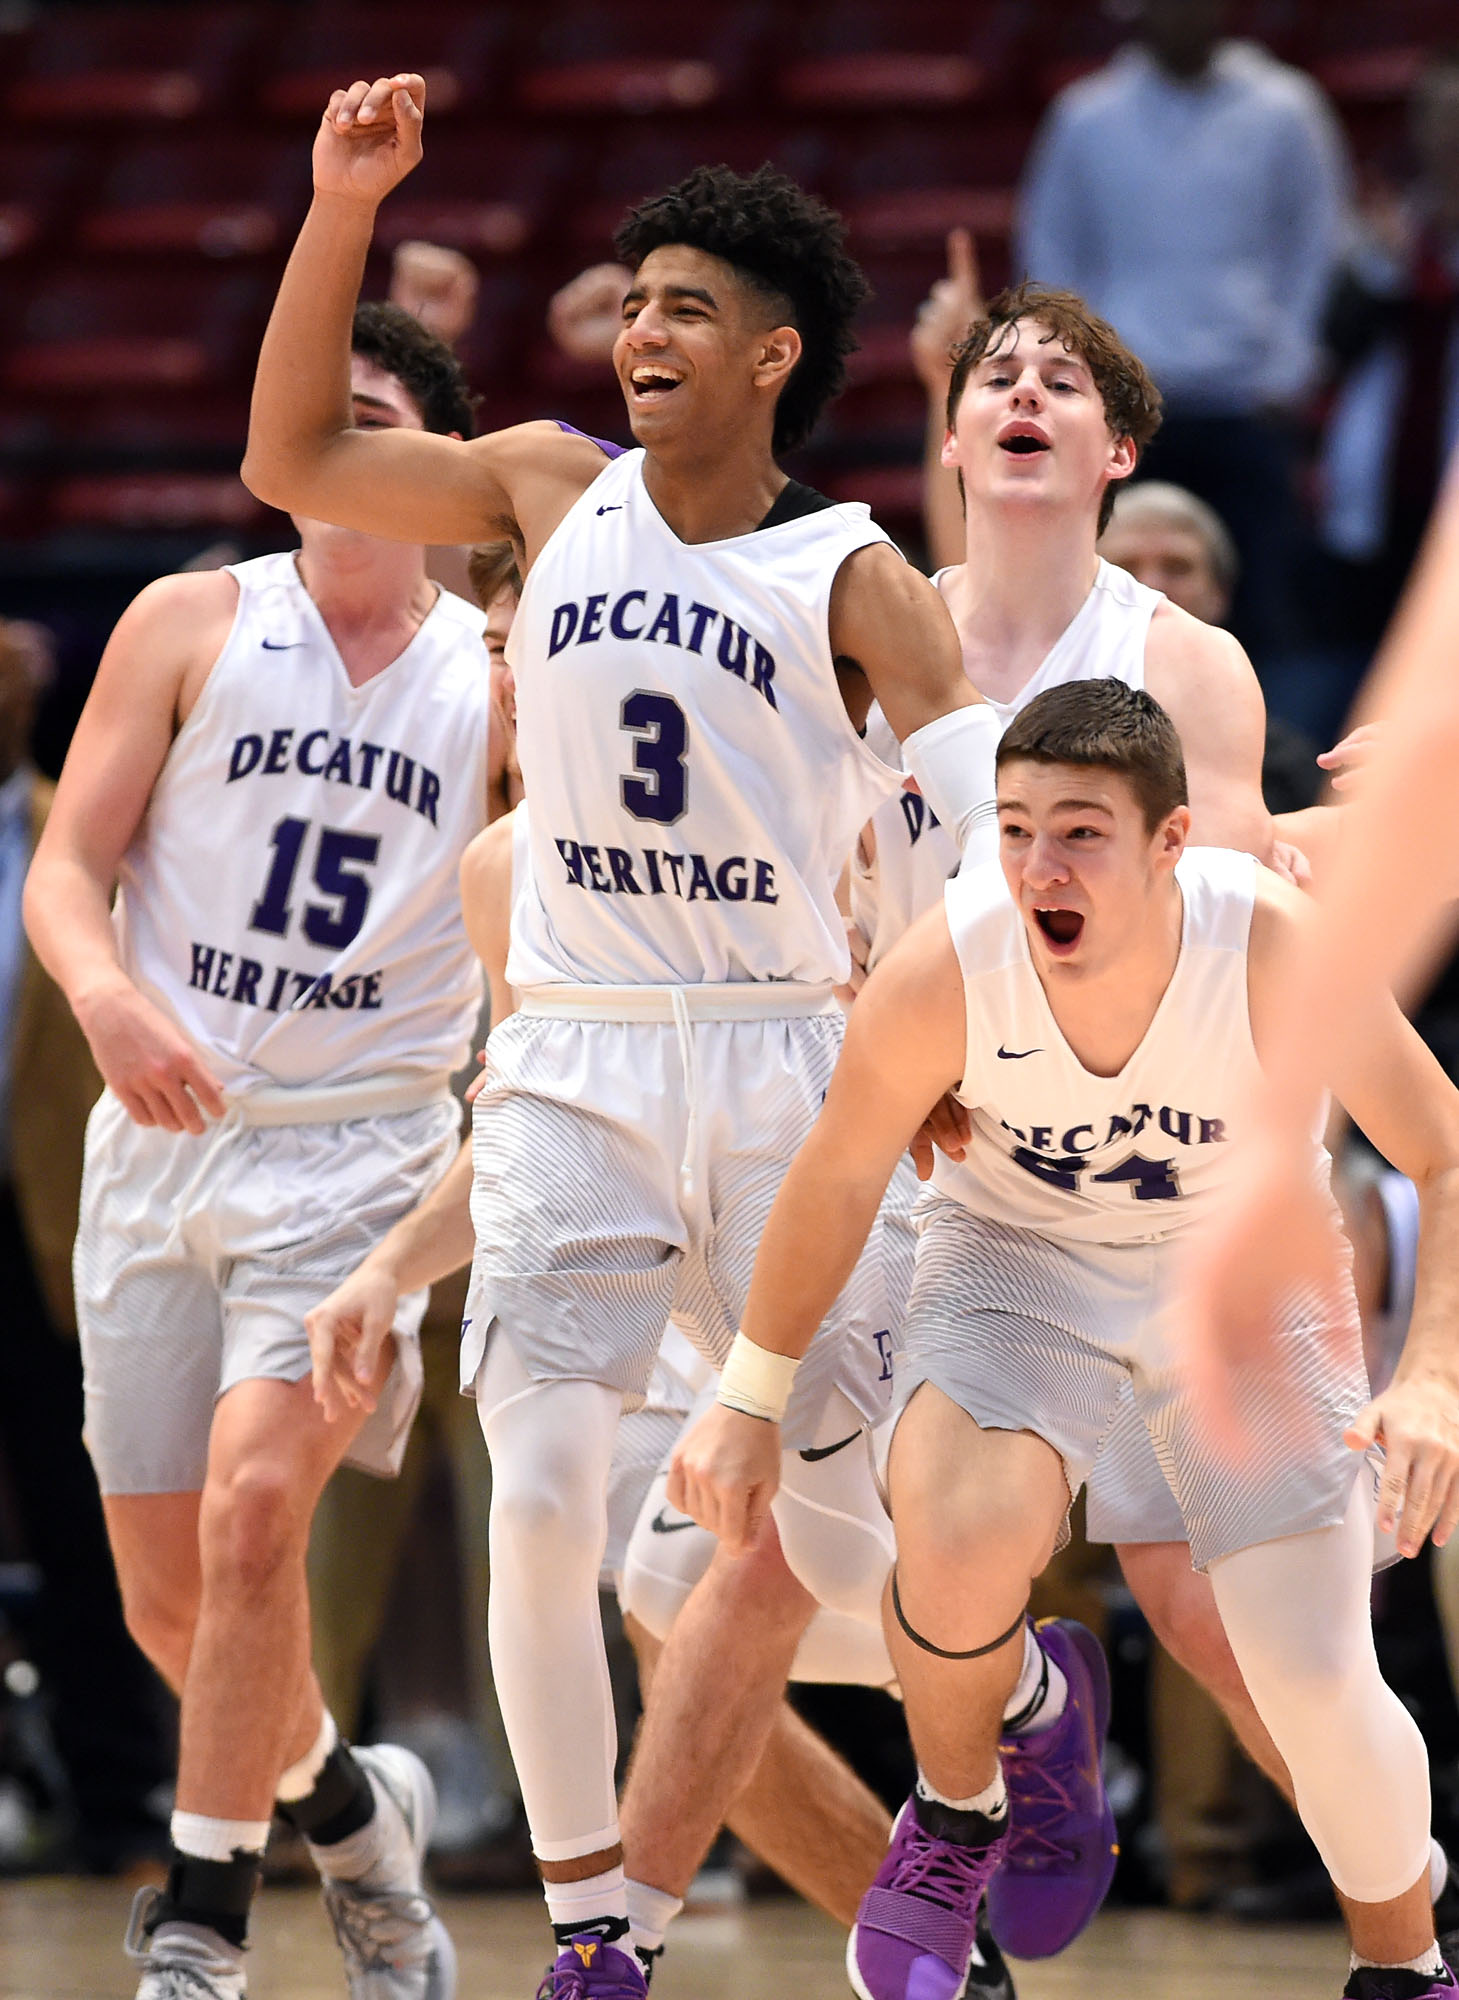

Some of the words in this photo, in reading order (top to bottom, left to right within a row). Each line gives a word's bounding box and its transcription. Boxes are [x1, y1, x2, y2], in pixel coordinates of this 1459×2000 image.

[547, 590, 780, 714] DECATUR
[226, 728, 441, 830] DECATUR
[619, 688, 690, 827] 3
[248, 813, 382, 951] 15
[554, 838, 780, 905] HERITAGE
[188, 943, 384, 1013] HERITAGE
